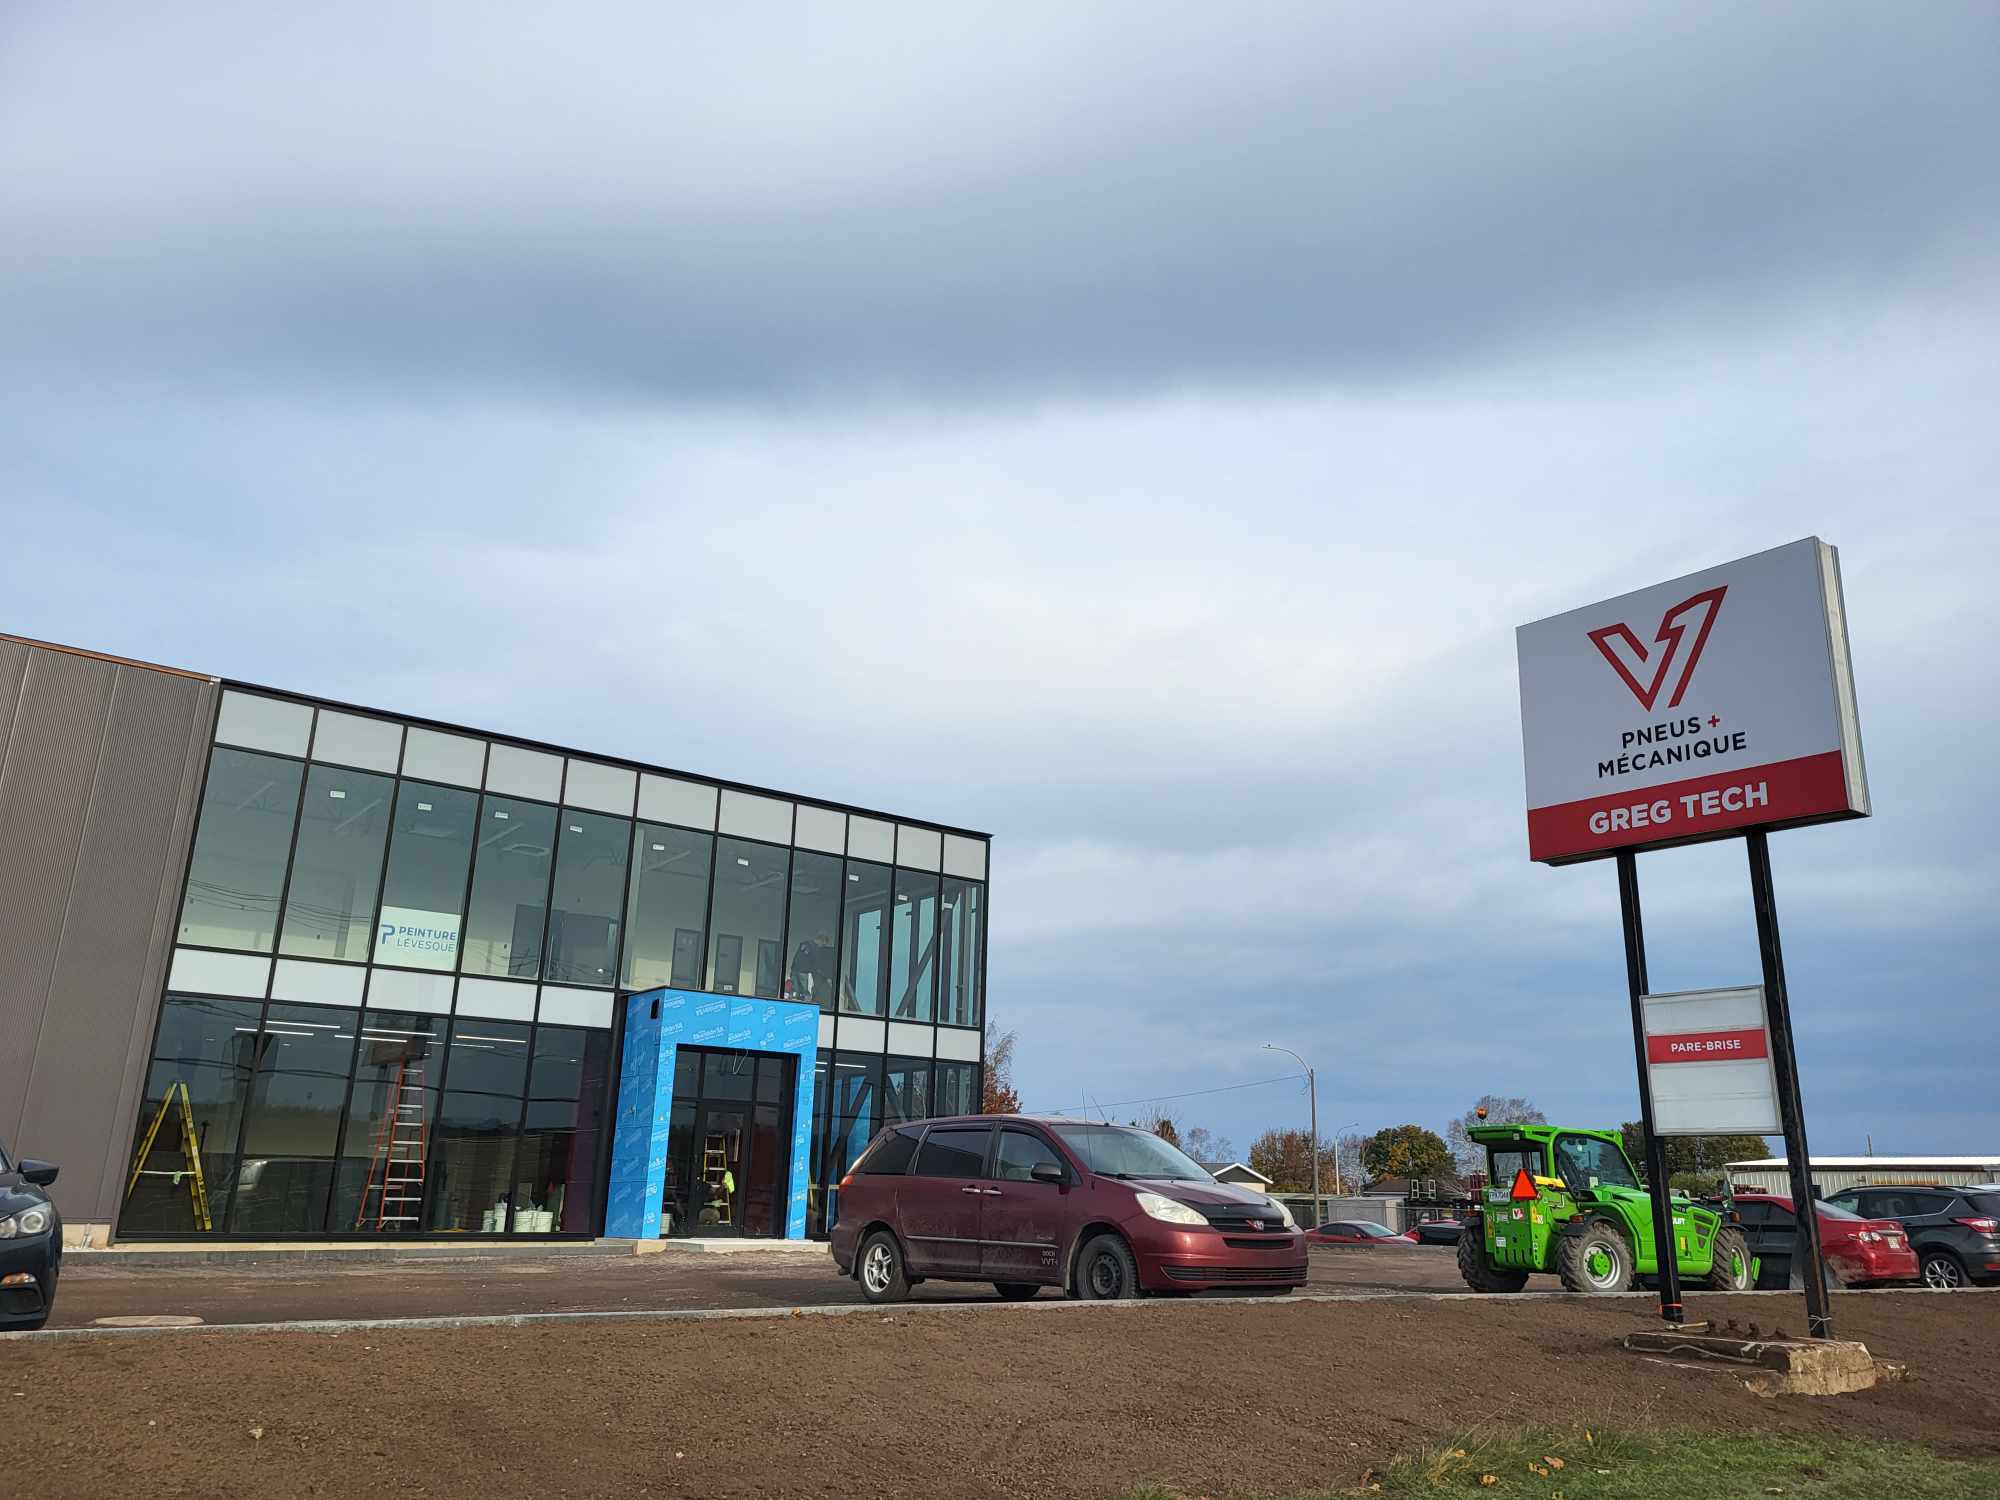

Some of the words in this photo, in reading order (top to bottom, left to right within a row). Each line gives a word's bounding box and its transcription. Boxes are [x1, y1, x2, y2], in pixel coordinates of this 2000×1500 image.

[1598, 731, 1747, 778] MÉCANIQUE
[1589, 800, 1672, 834] GREG
[1680, 782, 1768, 818] TECH
[399, 926, 456, 940] PEINTURE
[397, 938, 455, 953] LÉVESQUE
[1671, 1039, 1741, 1052] PARE-BRISE
